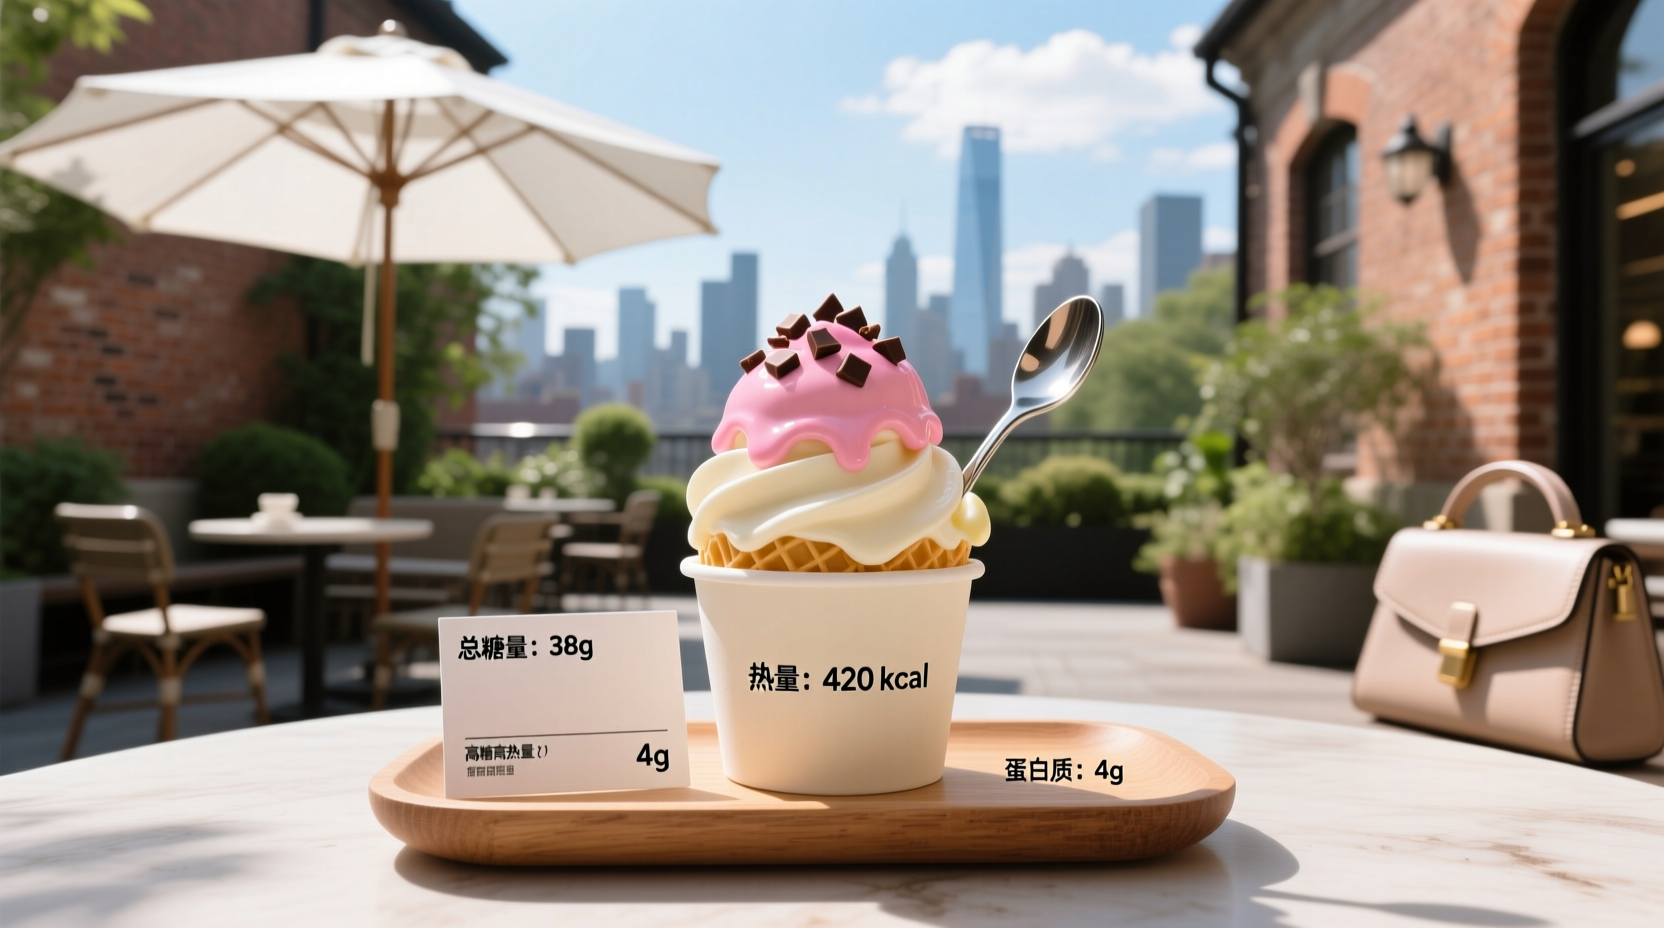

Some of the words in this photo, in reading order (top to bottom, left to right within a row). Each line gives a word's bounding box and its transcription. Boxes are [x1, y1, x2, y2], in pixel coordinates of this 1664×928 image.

[457, 634, 538, 661] 总糖量：
[549, 634, 594, 661] 38g
[748, 662, 810, 692] 热量：
[822, 665, 874, 692] 420
[880, 662, 929, 691] kcal
[636, 742, 670, 773] 4g
[1004, 756, 1083, 783] 蛋白质：
[1094, 759, 1124, 785] 4g
